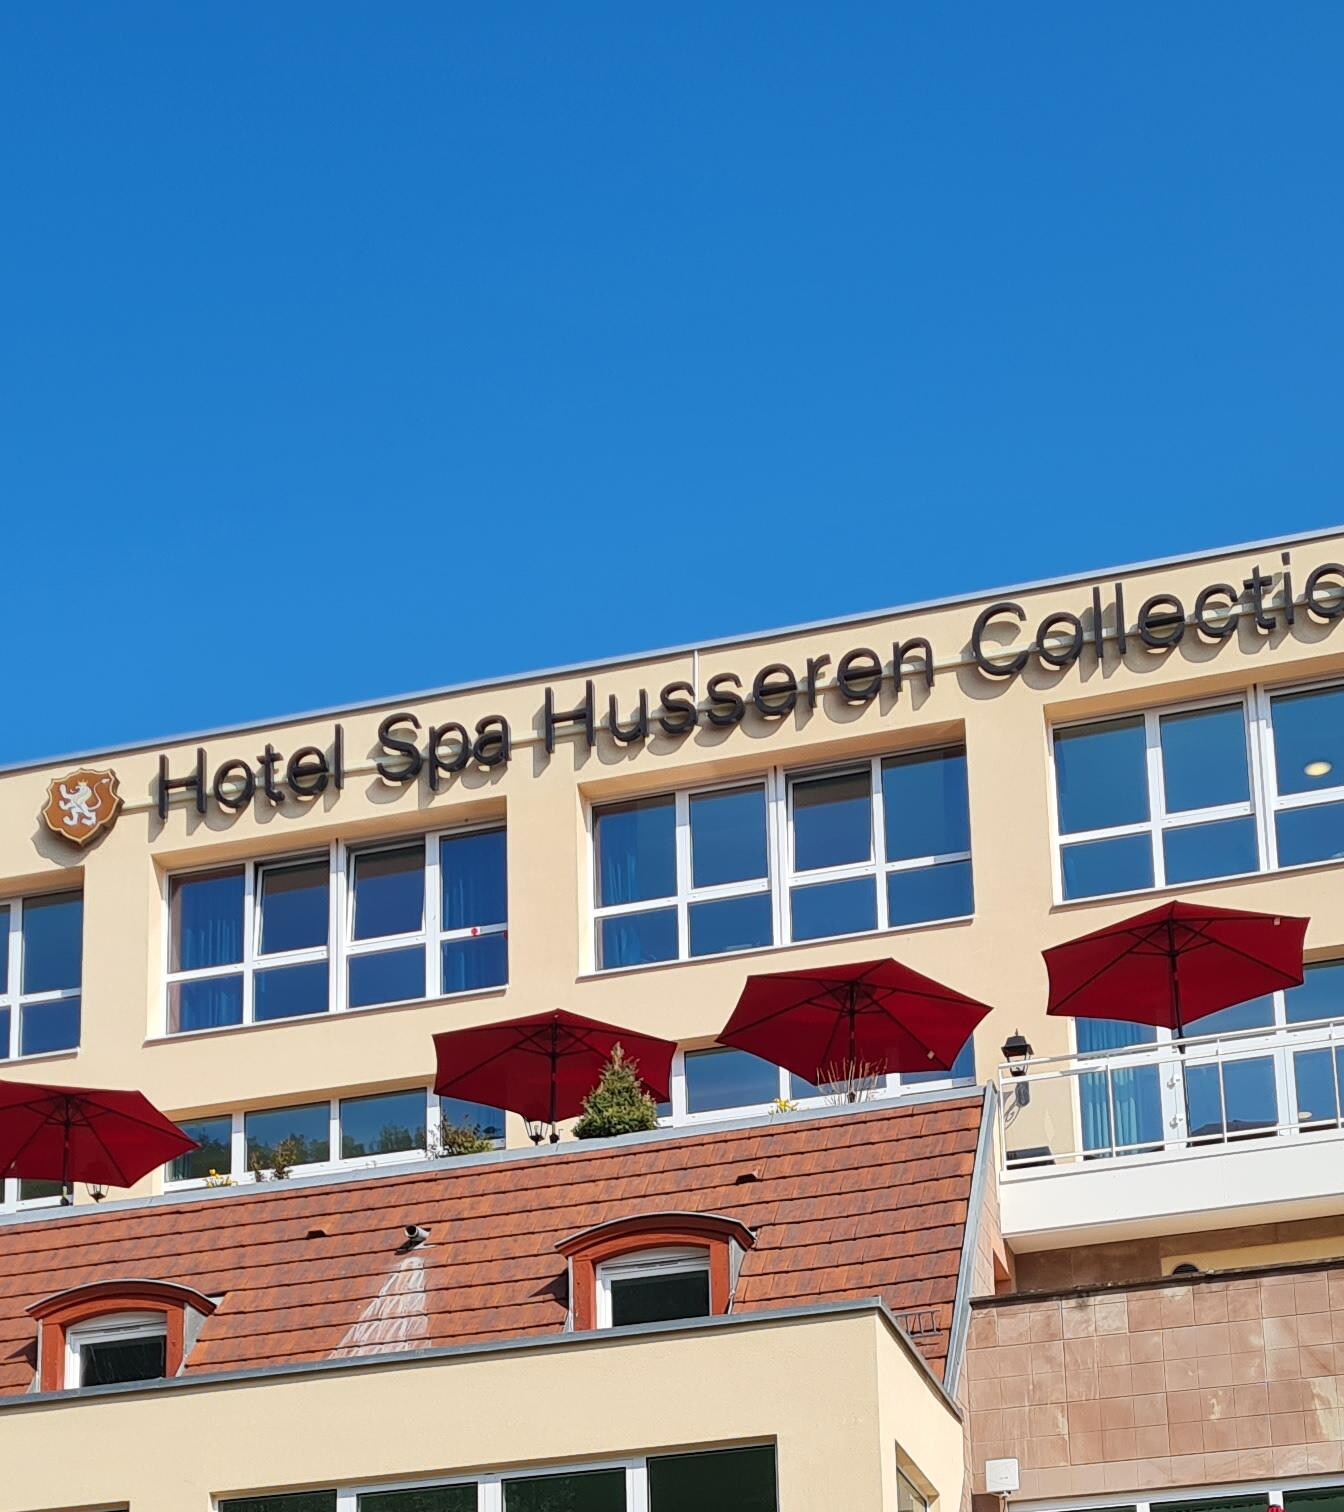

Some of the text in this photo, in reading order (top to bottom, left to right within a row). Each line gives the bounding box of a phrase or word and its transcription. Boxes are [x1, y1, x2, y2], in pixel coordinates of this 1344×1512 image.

[158, 722, 345, 822] Hotel
[375, 711, 512, 791] Spa
[544, 636, 935, 753] Husseren
